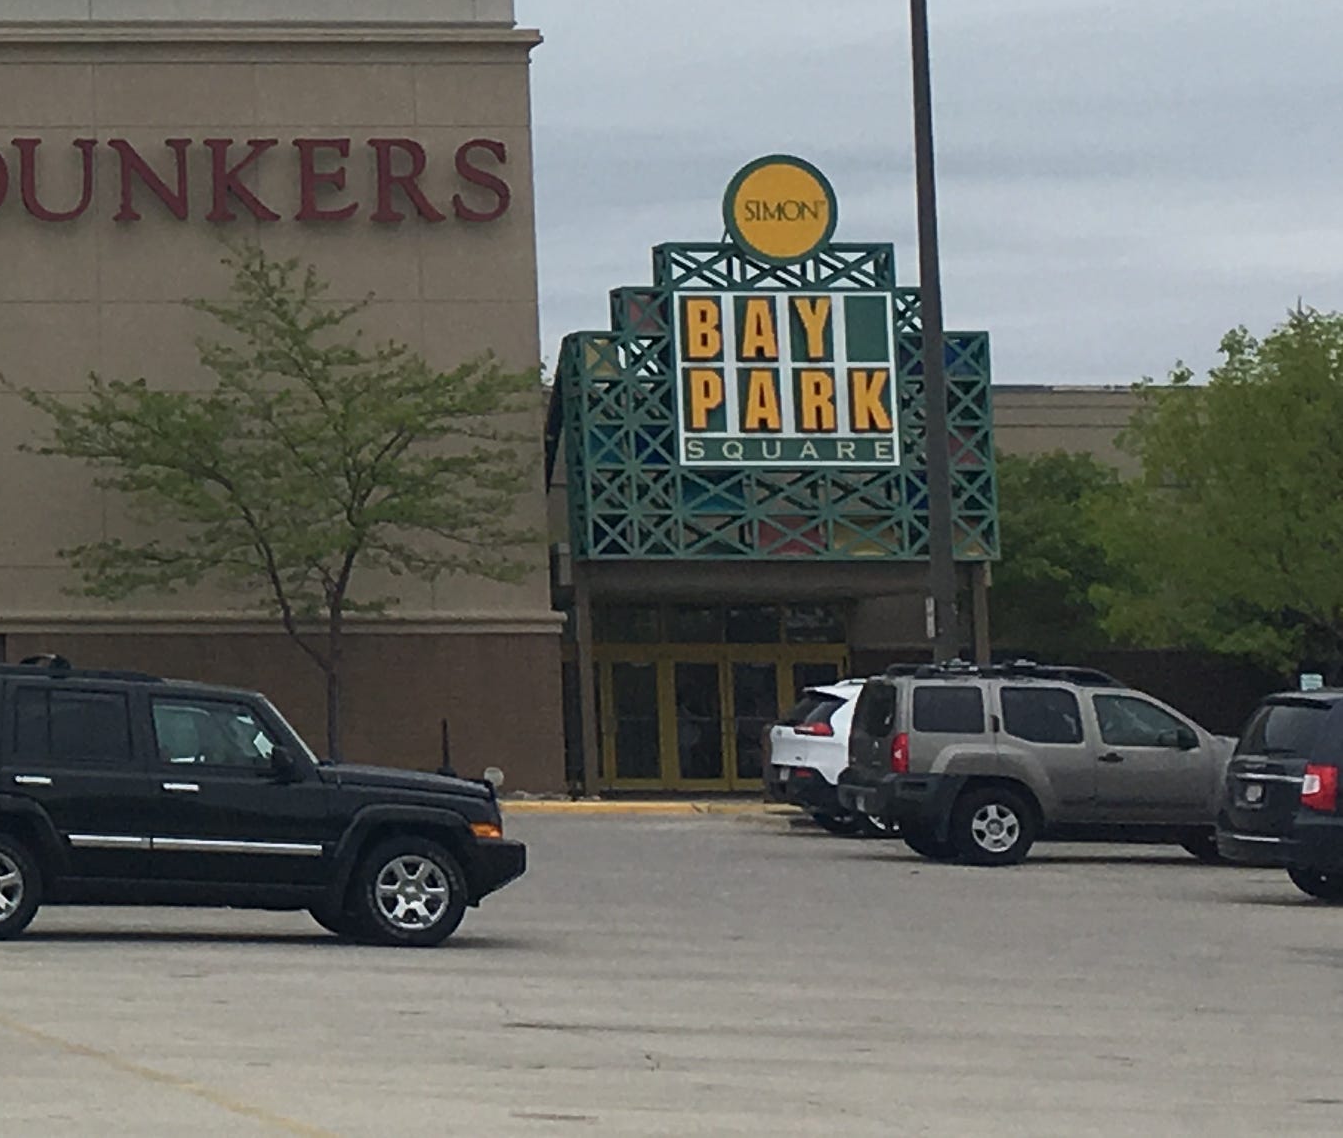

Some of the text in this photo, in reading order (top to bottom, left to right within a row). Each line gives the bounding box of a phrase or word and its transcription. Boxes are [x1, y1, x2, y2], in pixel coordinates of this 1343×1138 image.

[744, 200, 819, 222] SIMON
[686, 297, 831, 359] BAY
[689, 369, 894, 431] PARK
[687, 440, 894, 461] SQUARE
